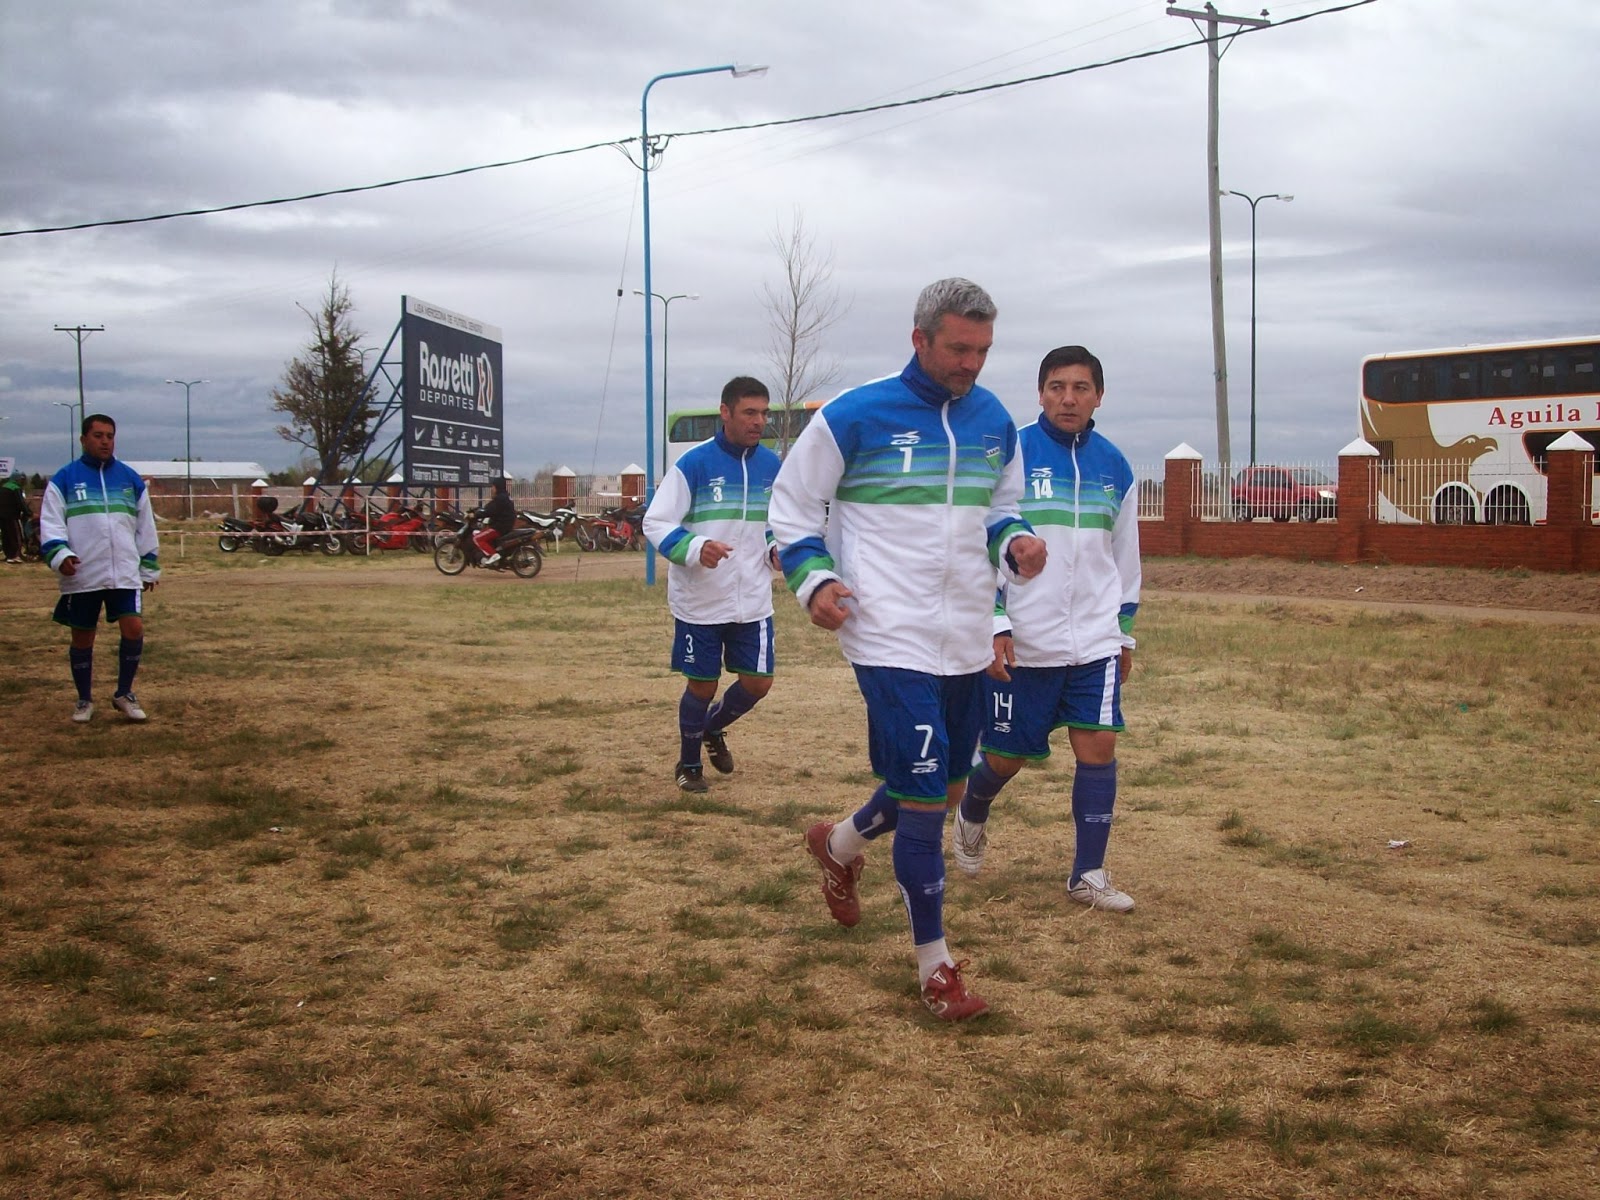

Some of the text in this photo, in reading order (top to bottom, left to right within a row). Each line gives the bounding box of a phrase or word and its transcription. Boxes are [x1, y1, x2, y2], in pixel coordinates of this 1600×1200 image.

[420, 341, 474, 396] Rossetti
[420, 389, 474, 411] DEPORTES
[1488, 403, 1581, 428] Aguila
[75, 489, 87, 501] 11
[713, 487, 723, 502] 3
[1031, 478, 1053, 499] 14
[685, 634, 694, 654] 3
[993, 691, 1012, 720] 14
[914, 724, 933, 759] 7
